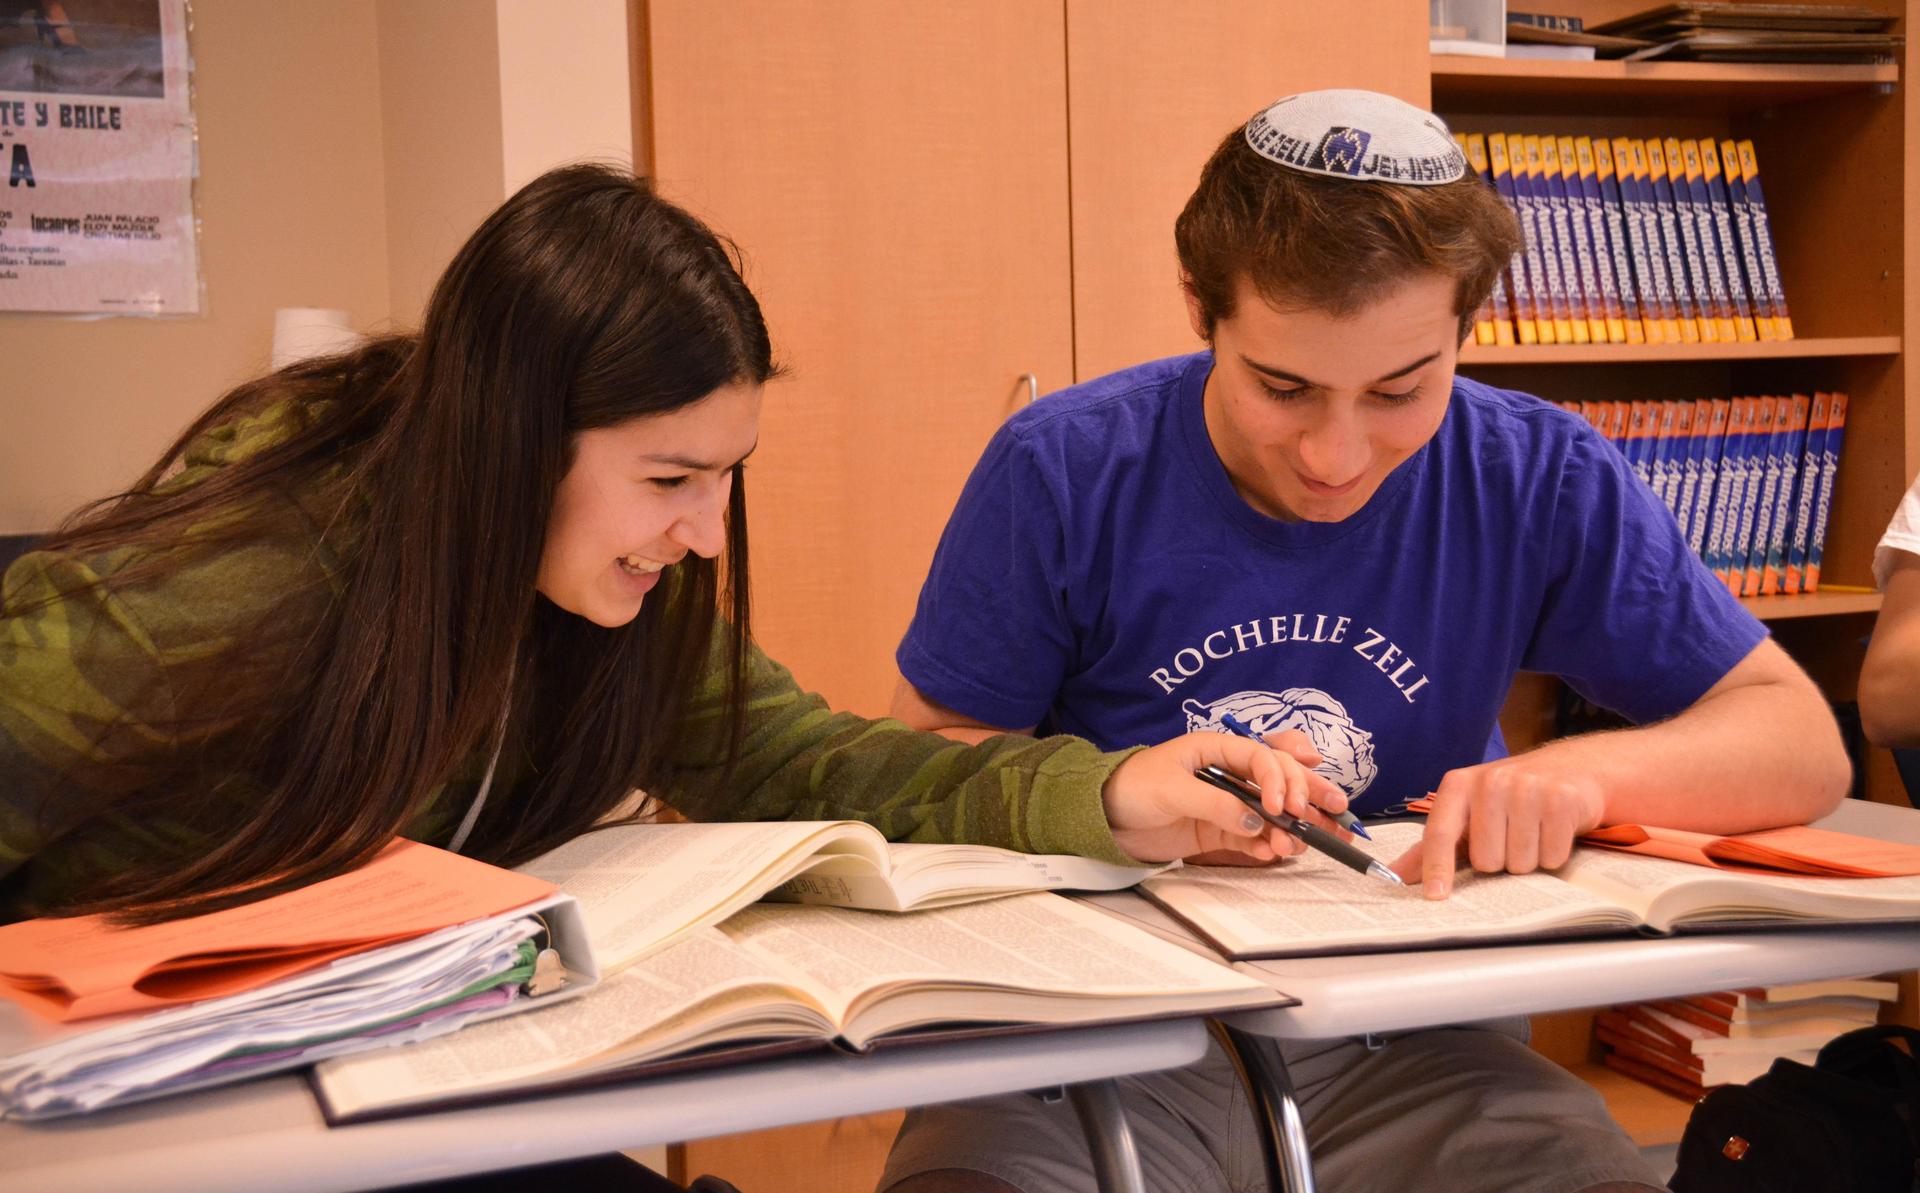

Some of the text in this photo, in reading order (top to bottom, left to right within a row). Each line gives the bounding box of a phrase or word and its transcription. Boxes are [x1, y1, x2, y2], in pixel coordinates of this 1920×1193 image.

[34, 102, 48, 127] Y
[60, 103, 121, 130] BAILE
[0, 143, 36, 188] A
[1362, 153, 1447, 181] JEWISH
[1149, 613, 1430, 704] ROCHELLE ZELL
